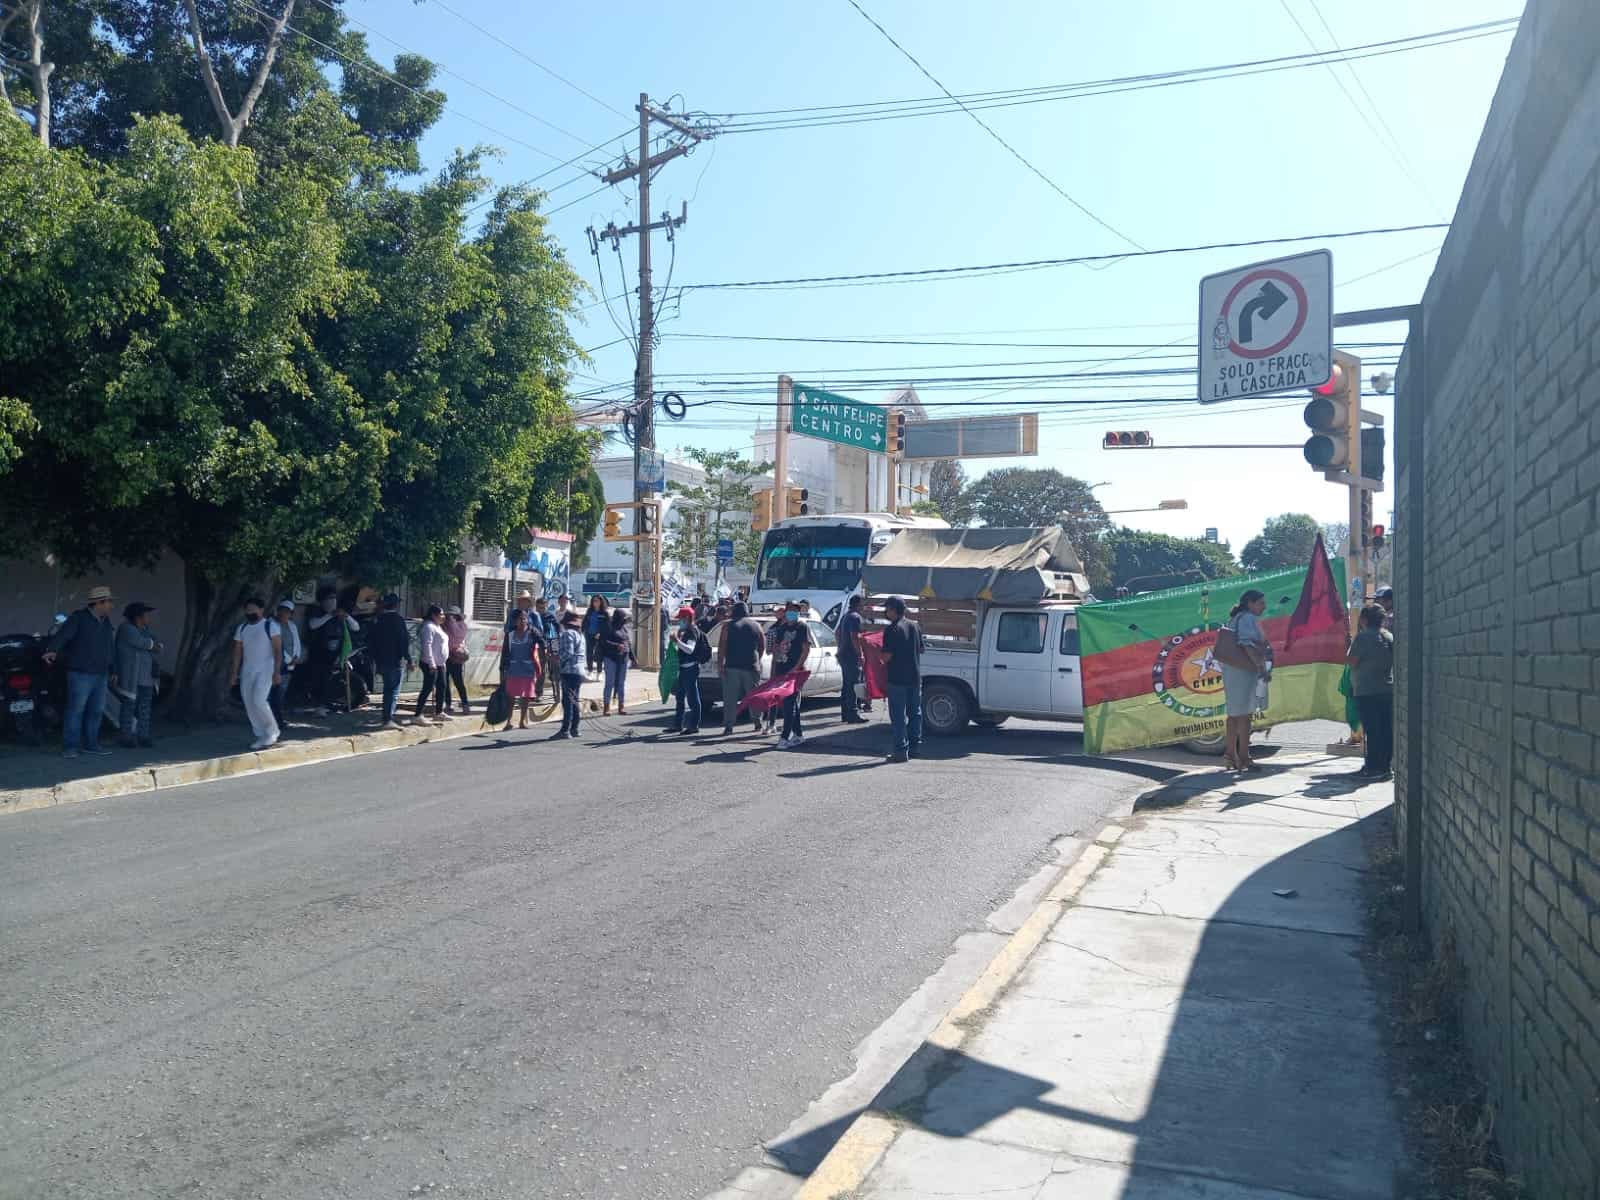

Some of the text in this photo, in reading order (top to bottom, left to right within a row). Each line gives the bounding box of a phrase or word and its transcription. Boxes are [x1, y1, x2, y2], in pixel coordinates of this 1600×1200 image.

[1214, 370, 1306, 397] LA CASCADA
[1219, 362, 1254, 380] SOLO
[812, 398, 884, 427] SAN FELIPE
[800, 414, 862, 440] CENTRO
[1174, 720, 1224, 735] MOVIMIENTO
